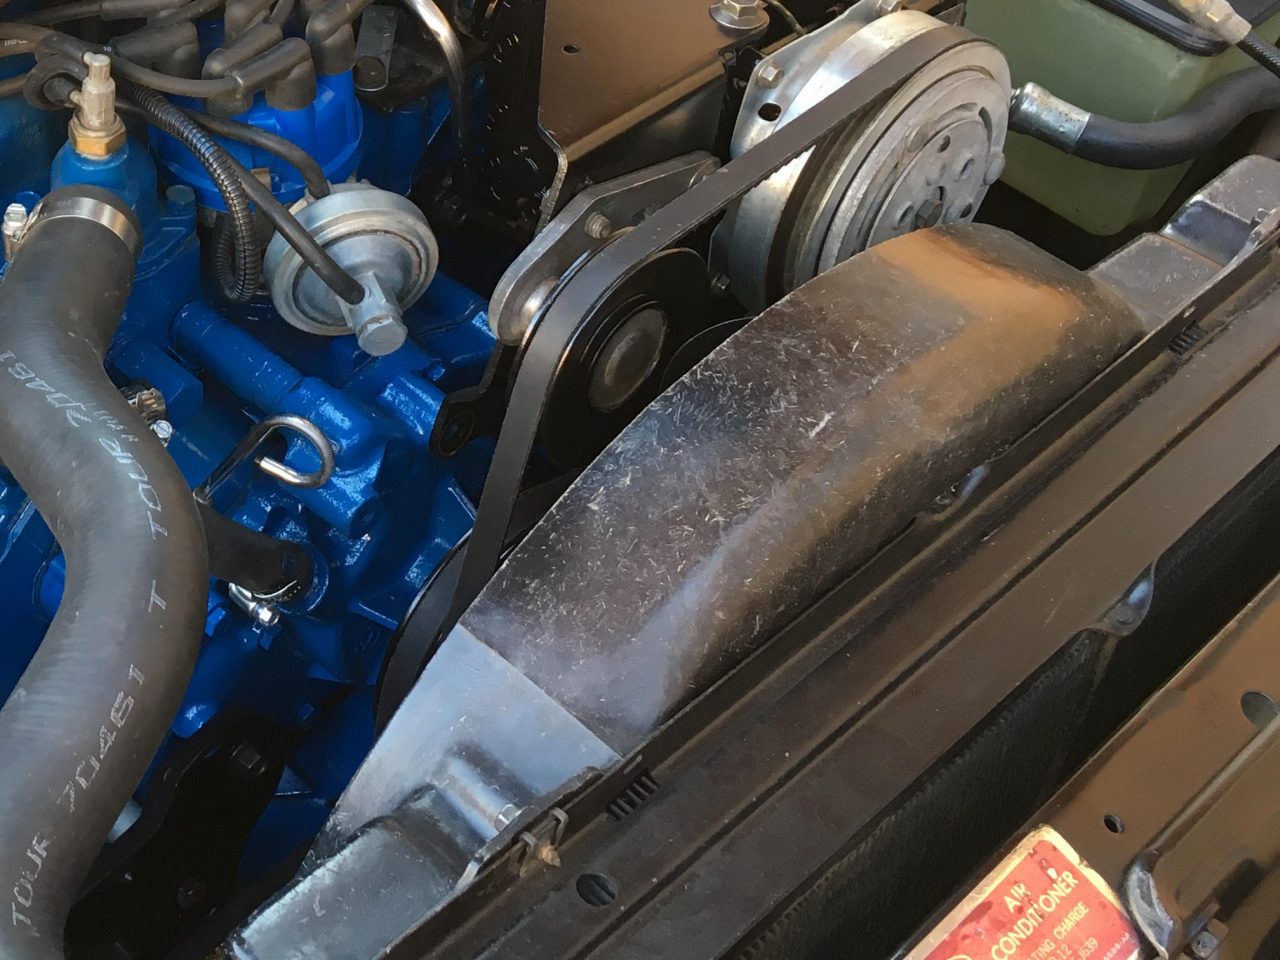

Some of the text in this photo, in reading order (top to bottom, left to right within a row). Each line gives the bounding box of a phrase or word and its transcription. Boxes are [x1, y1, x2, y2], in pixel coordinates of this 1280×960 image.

[991, 870, 1079, 960] CONDITONER
[1003, 882, 1031, 913] AIR
[1053, 901, 1090, 940] CHARGE
